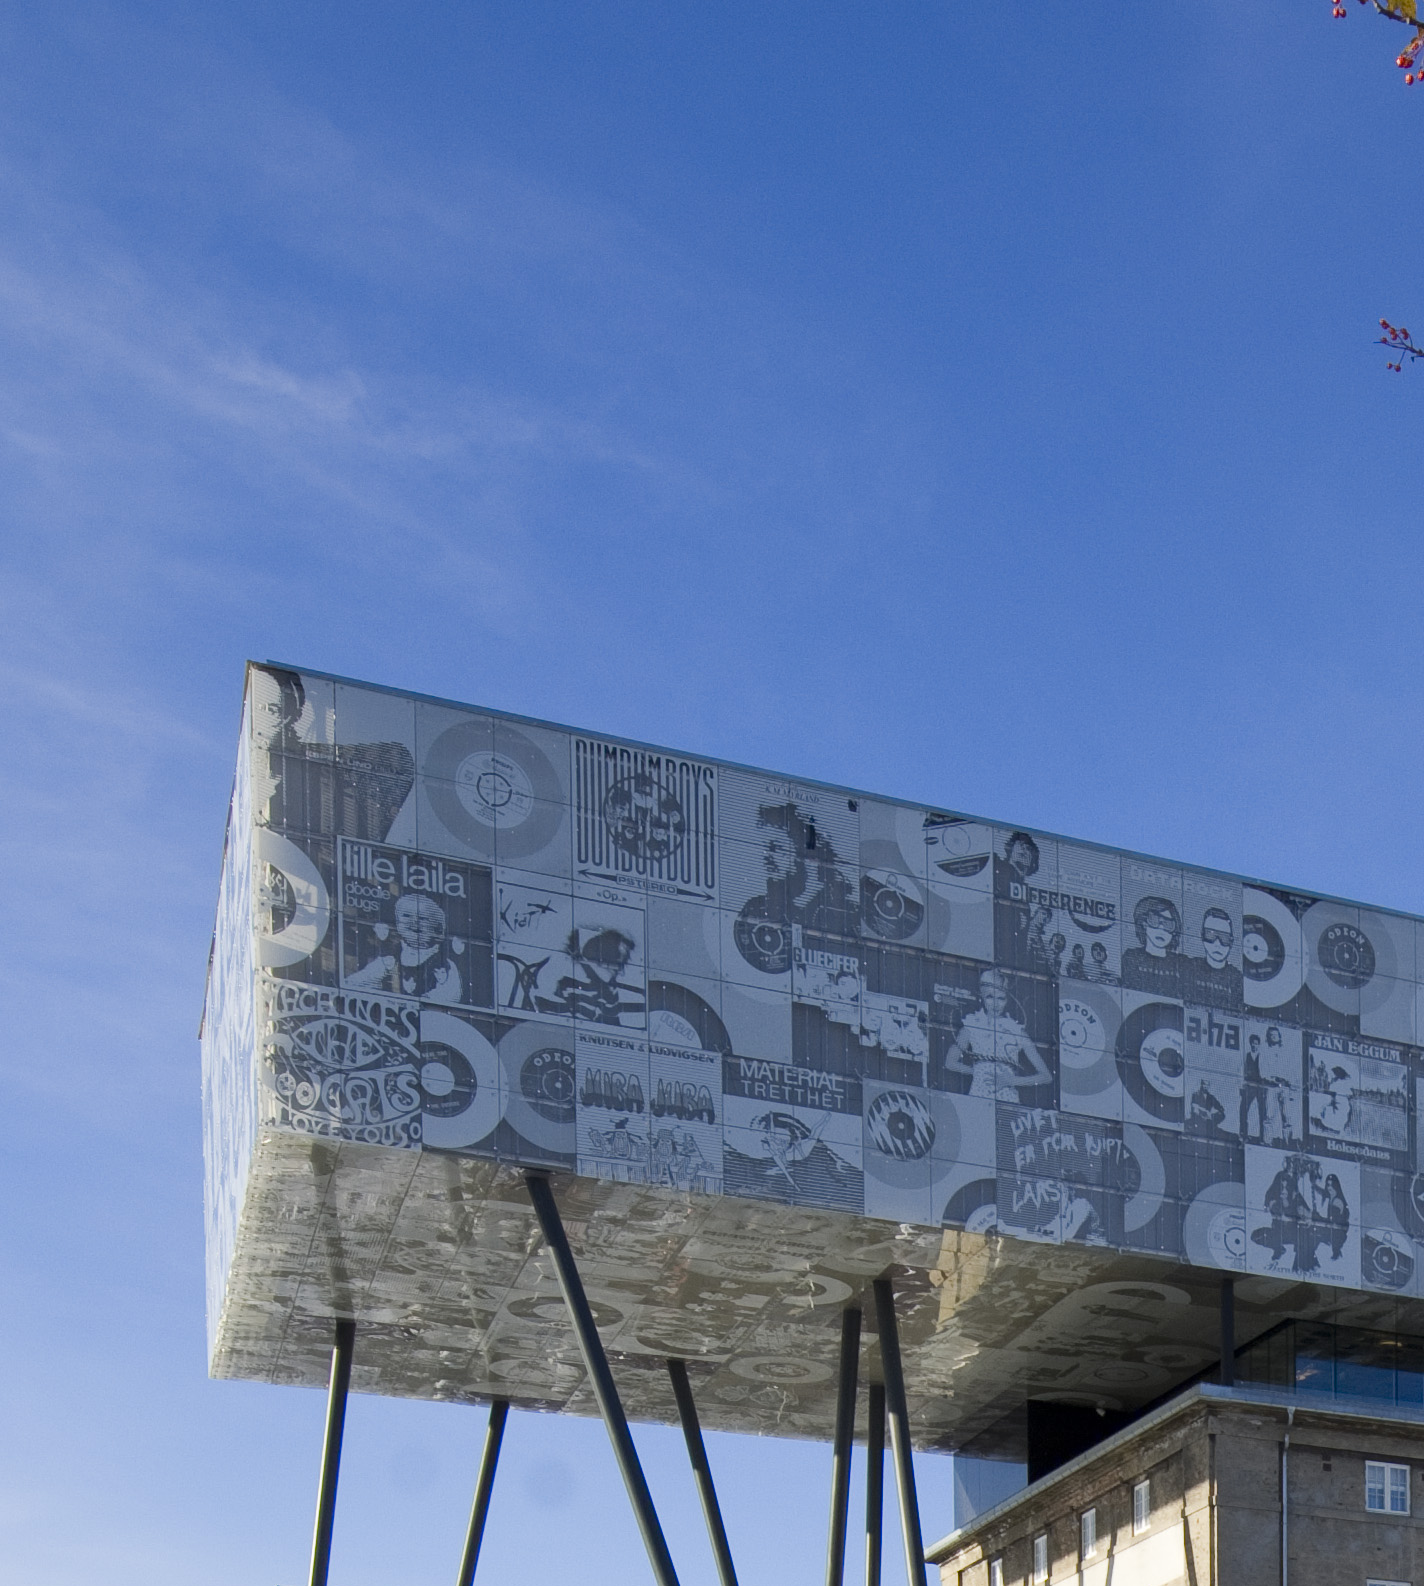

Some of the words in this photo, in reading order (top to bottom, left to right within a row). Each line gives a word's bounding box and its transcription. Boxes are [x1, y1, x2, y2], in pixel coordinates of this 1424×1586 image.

[345, 843, 395, 884] lille
[402, 855, 467, 899] laila
[346, 895, 380, 913] bugs
[1328, 927, 1365, 945] ODEON
[793, 947, 859, 975] GLUECIFER
[1059, 1003, 1097, 1024] ODEON
[1186, 1011, 1240, 1051] a-ha
[533, 1051, 575, 1068] ODEO
[579, 1033, 635, 1050] KNUTSEN
[649, 1044, 715, 1064] LUDVIGSEN
[1314, 1033, 1343, 1052] JAN
[1348, 1040, 1401, 1063] EGGUM
[740, 1058, 844, 1093] MATERIAL
